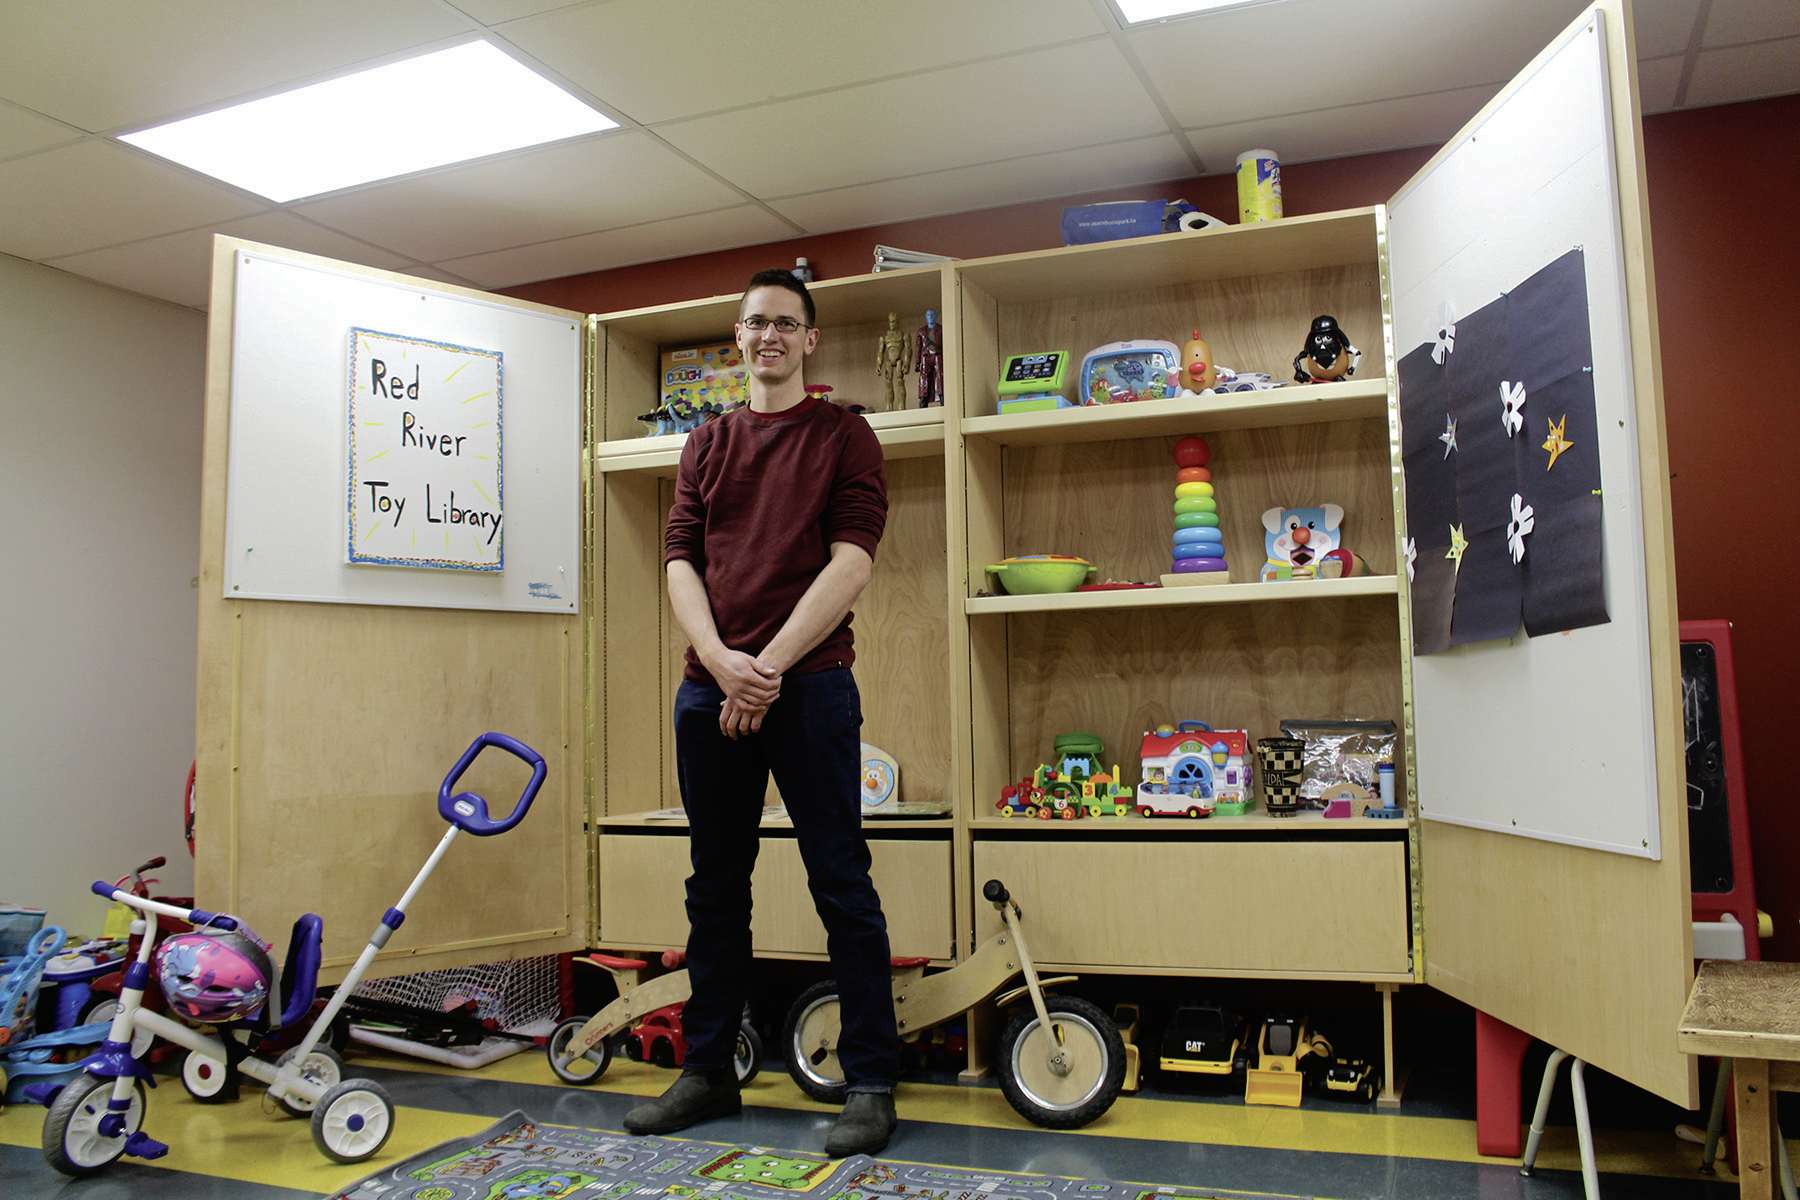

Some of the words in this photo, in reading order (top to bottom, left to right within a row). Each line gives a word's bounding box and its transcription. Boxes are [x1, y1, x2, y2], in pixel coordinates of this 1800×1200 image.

[371, 358, 420, 400] Red
[402, 411, 467, 456] River
[363, 481, 406, 528] Toy
[426, 483, 502, 545] Library
[1084, 784, 1093, 796] 3
[1109, 784, 1119, 795] 4
[1058, 800, 1065, 808] 6
[1185, 1040, 1201, 1052] CAT
